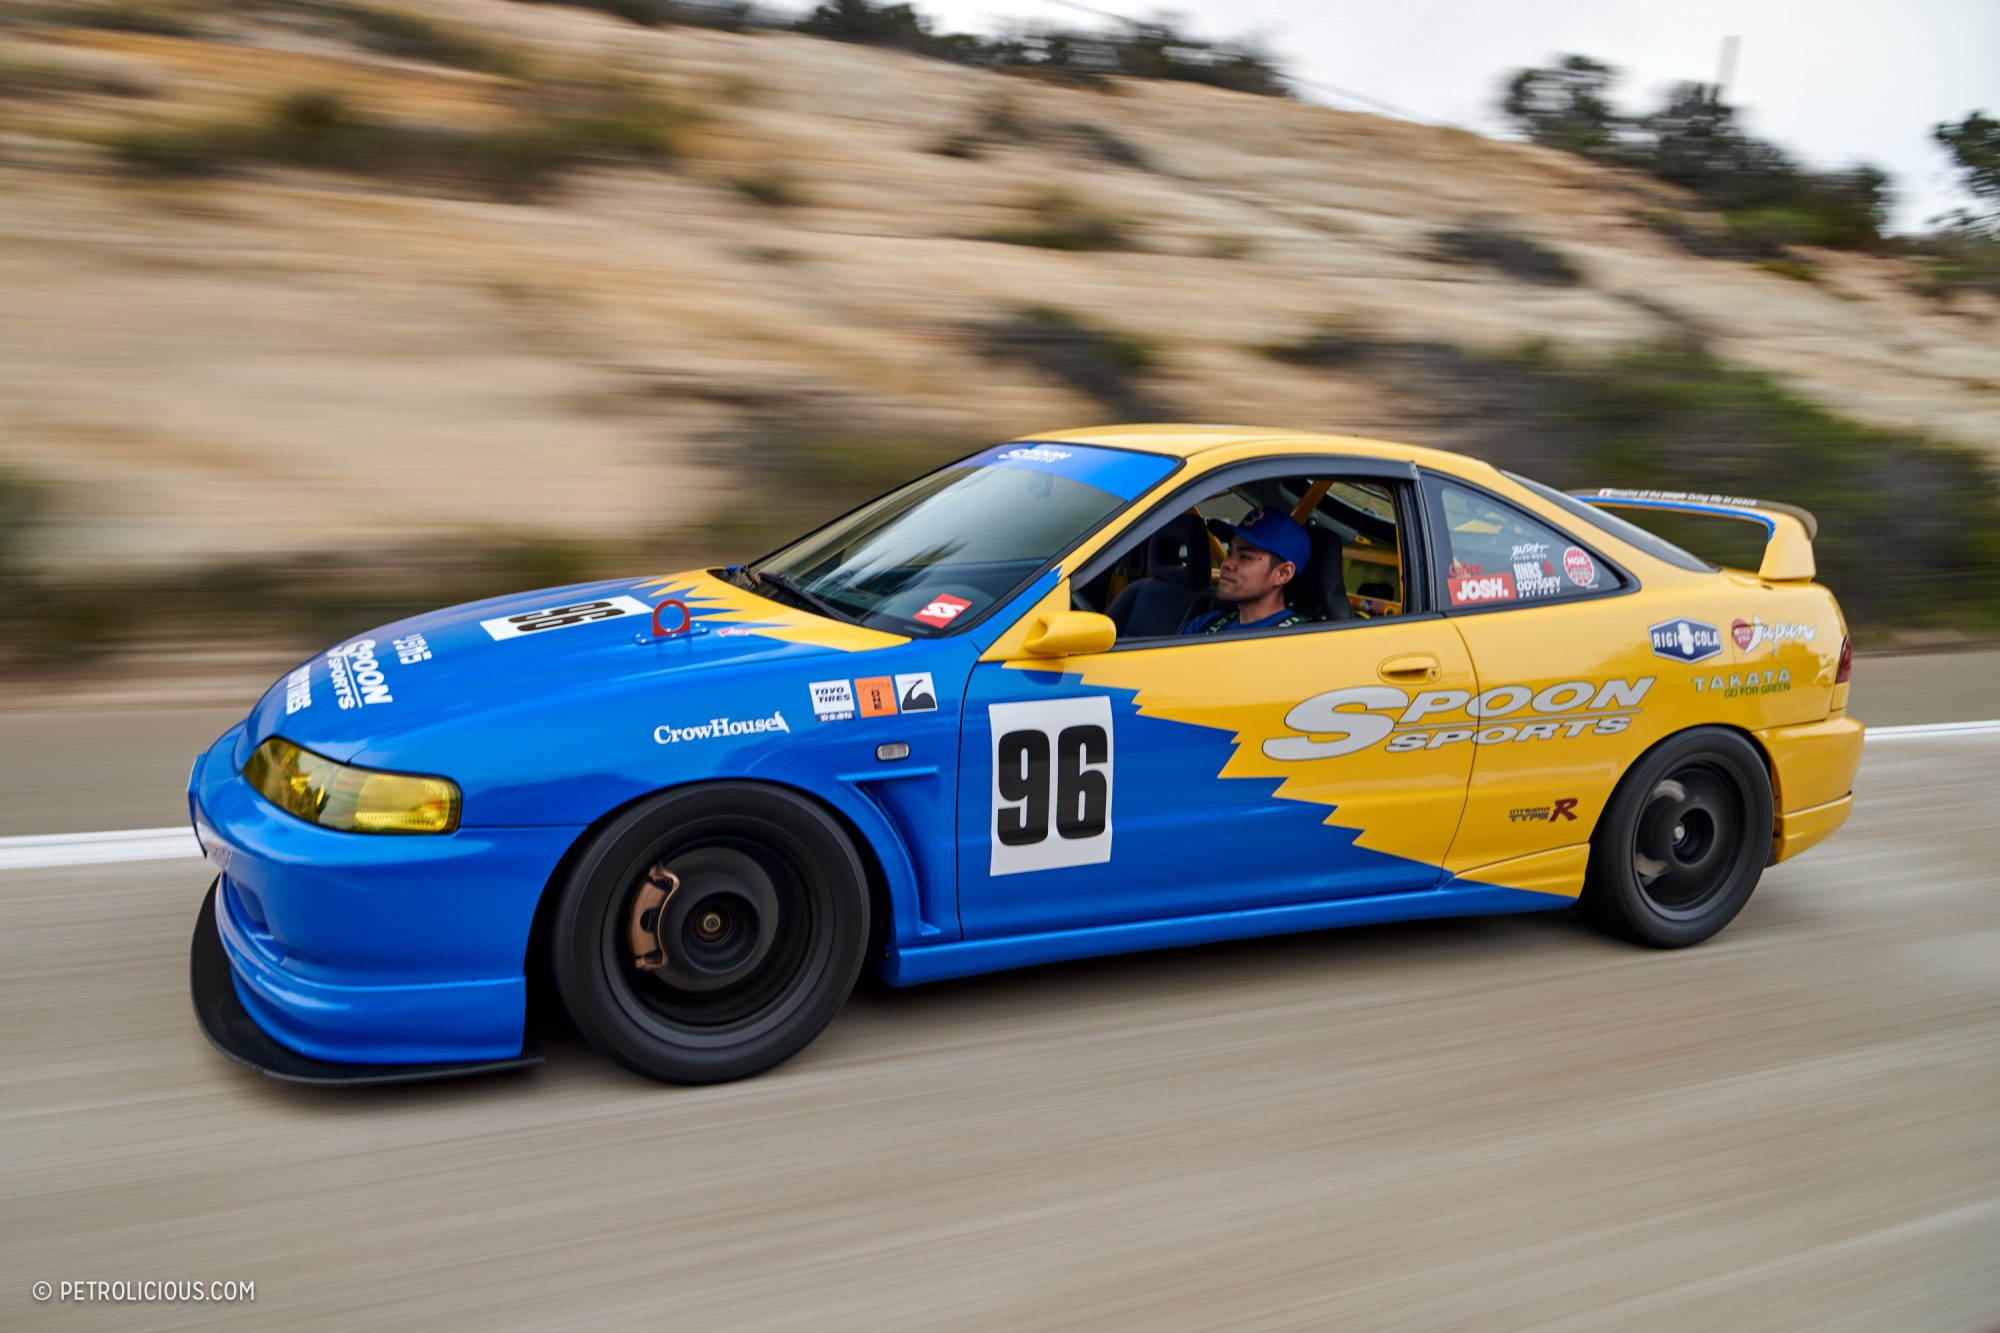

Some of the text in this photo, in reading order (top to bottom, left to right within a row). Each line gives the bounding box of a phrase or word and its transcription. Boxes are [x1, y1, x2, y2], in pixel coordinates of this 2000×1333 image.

[1456, 577, 1509, 601] JOSH.
[1516, 576, 1561, 592] ODYSSEY
[1518, 587, 1561, 599] BATTERY
[1652, 631, 1720, 649] RIGI COLA
[326, 639, 394, 705] SPOON
[328, 656, 356, 711] SPORTS
[1692, 668, 1791, 693] TAKATA
[814, 686, 845, 696] TOYO
[818, 693, 851, 703] TIRES
[1724, 682, 1791, 698] GO FOR GREEN
[653, 714, 780, 745] CrowHouse
[1262, 676, 1658, 761] SPOON
[1384, 716, 1634, 753] SPORTS
[998, 725, 1108, 846] 96
[1548, 797, 1579, 824] R
